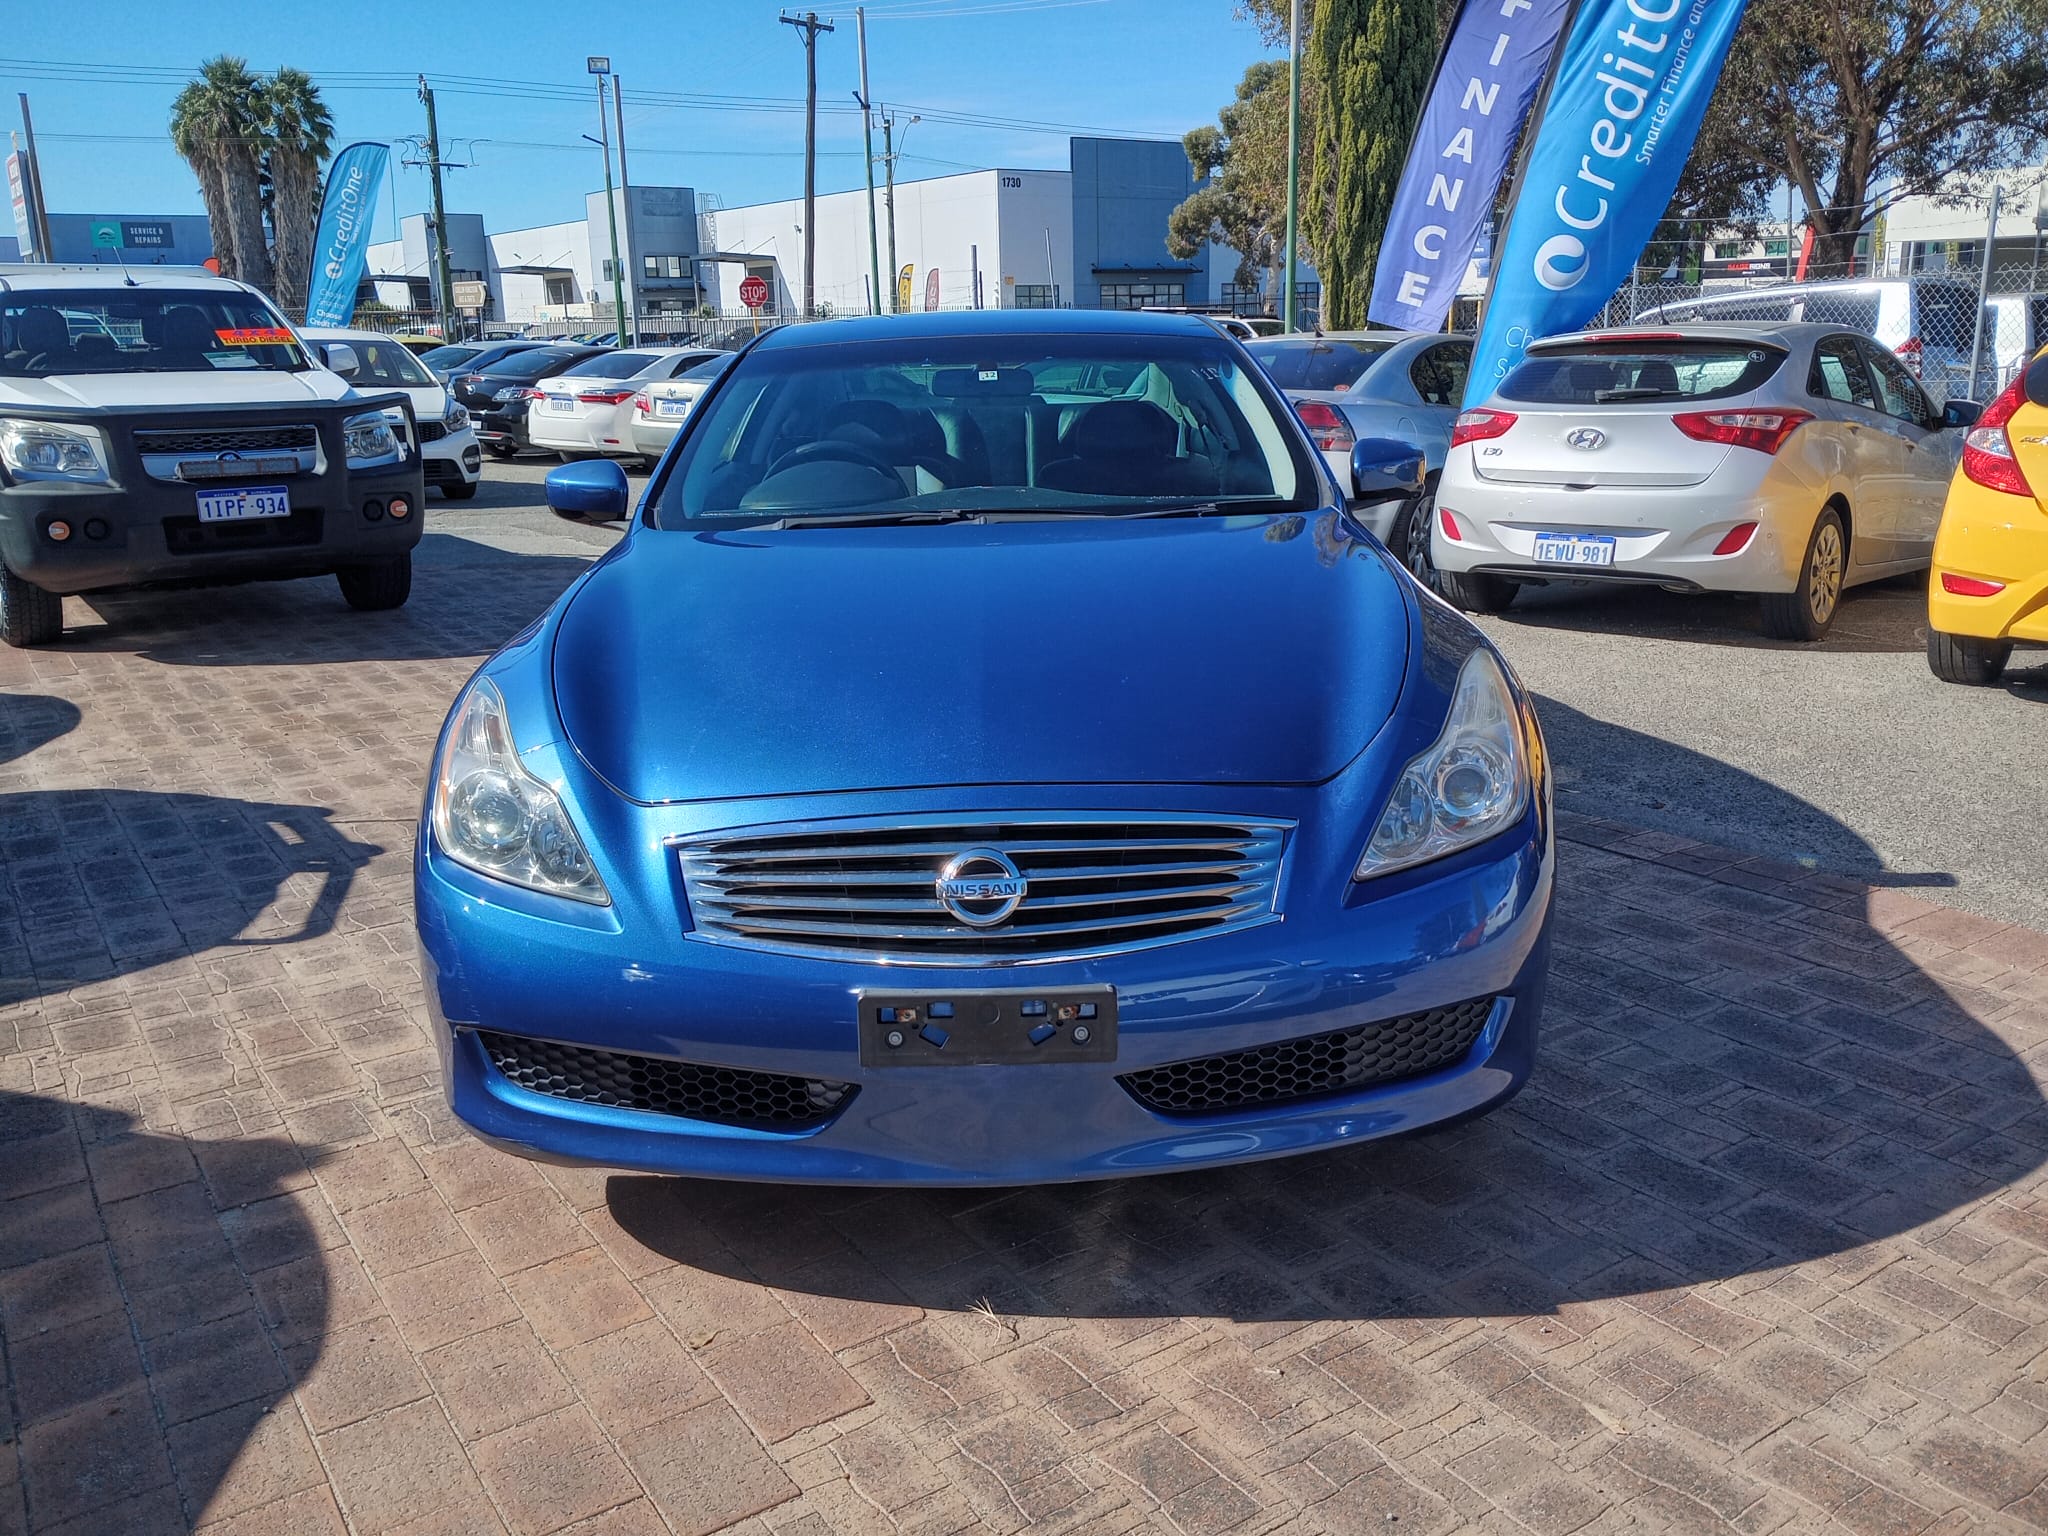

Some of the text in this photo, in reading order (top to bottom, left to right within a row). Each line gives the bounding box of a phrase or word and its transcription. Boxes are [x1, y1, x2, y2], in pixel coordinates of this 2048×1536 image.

[1635, 97, 1670, 165] Smarter
[1660, 28, 1696, 95] Finance
[1002, 176, 1021, 188] 1730
[328, 166, 363, 262] CreditOne
[130, 227, 156, 235] SERVICE
[134, 236, 162, 244] REPAIRS
[741, 286, 766, 299] STOP
[224, 334, 295, 345] TURBO DIESEL
[945, 882, 1018, 896] NISSAN
